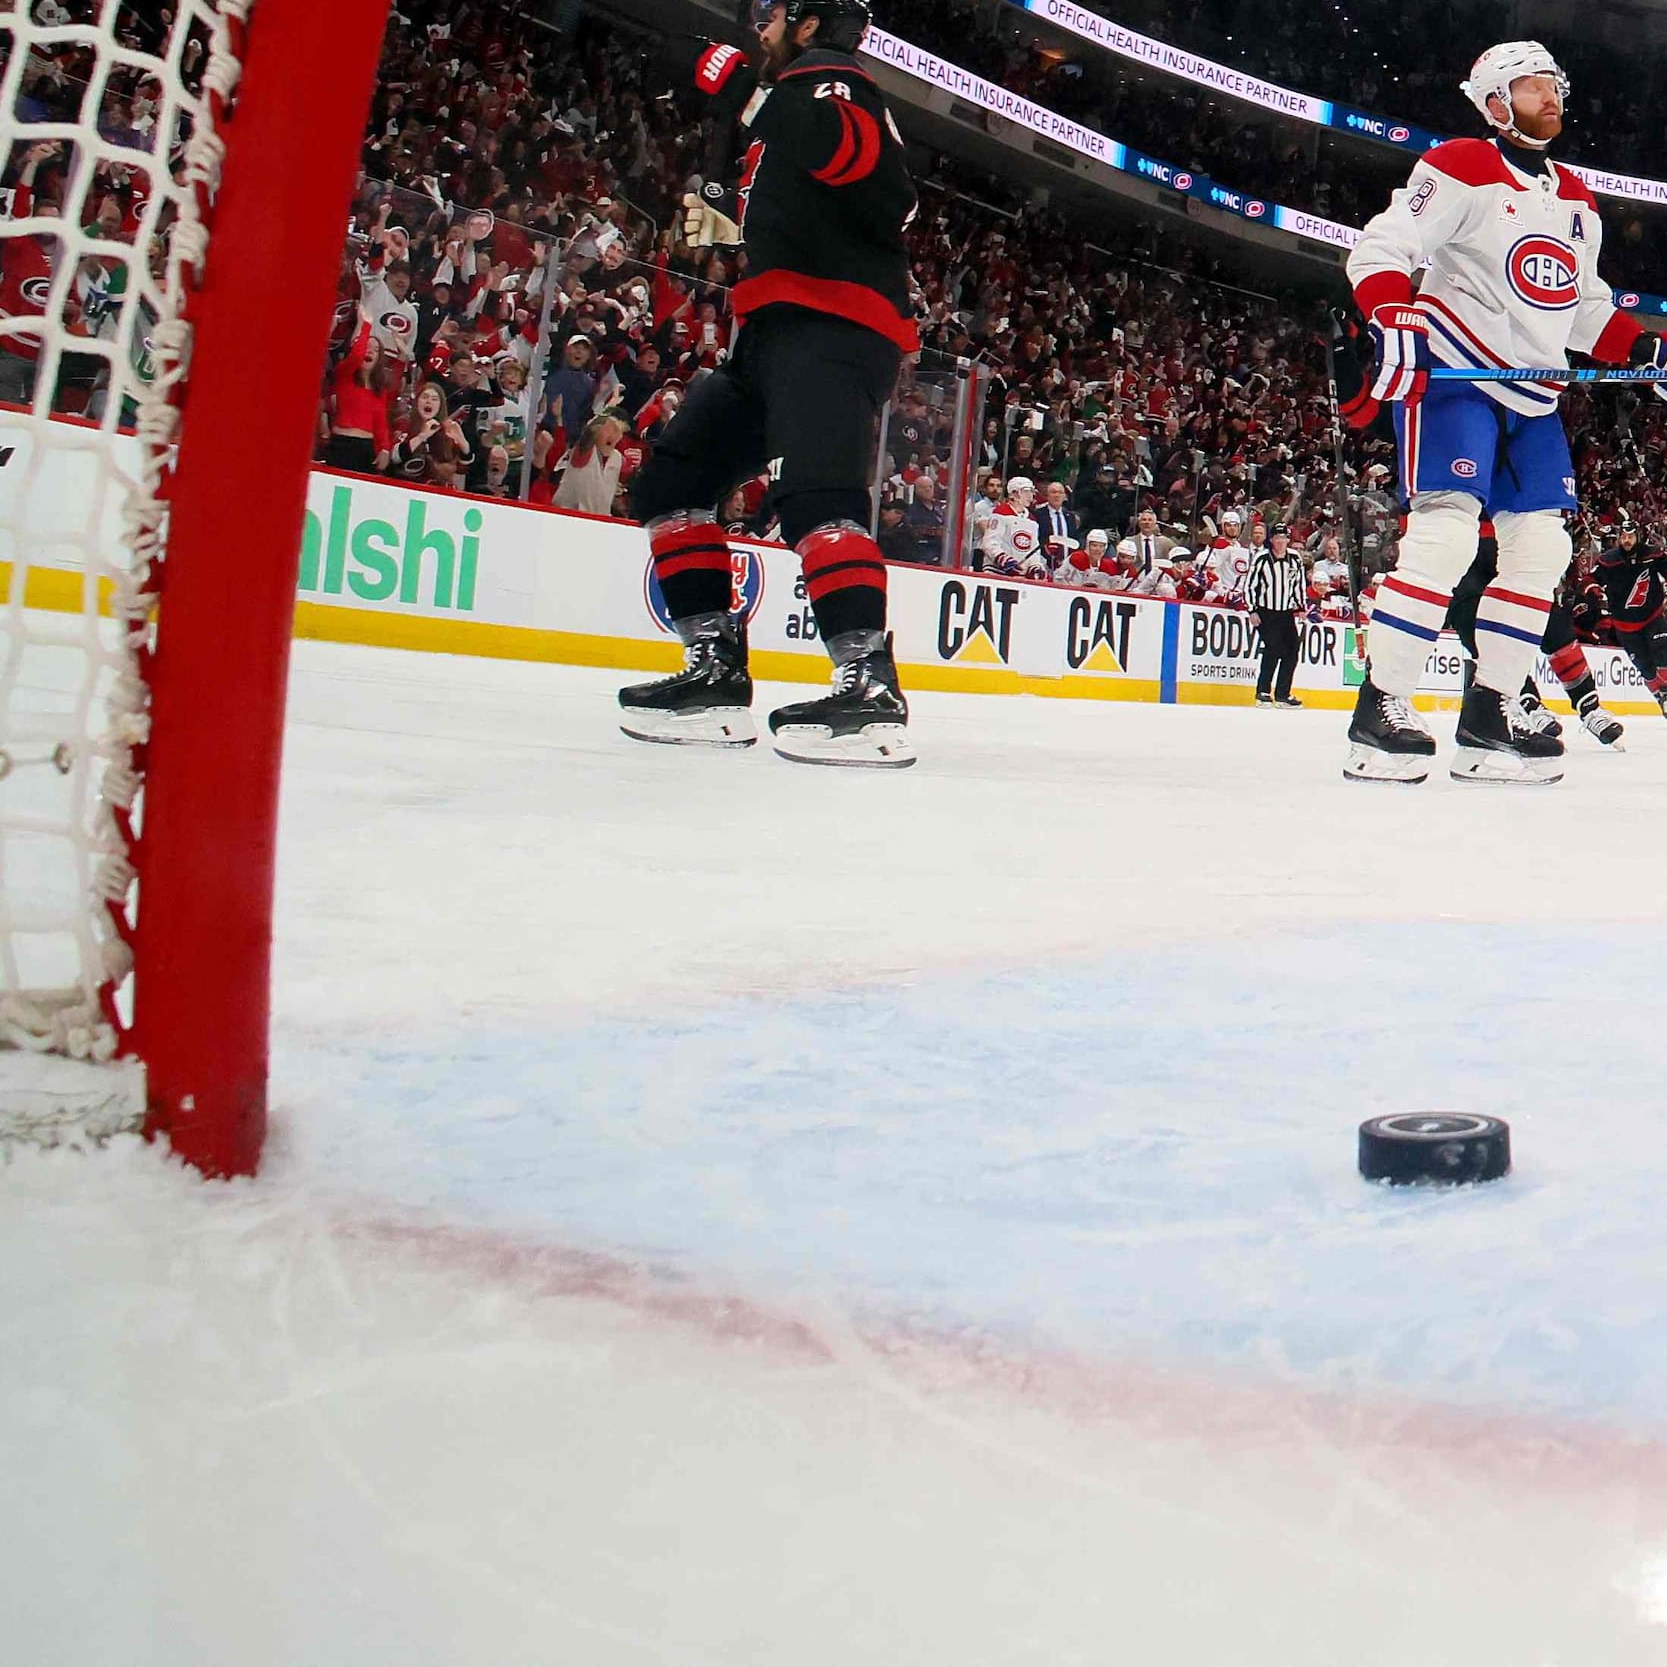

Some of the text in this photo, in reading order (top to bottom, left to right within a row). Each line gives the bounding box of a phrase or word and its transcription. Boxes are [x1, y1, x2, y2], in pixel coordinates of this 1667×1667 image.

[1048, 0, 1307, 114] OFFICIAL HEALTH INSURANCE PARTNER
[917, 54, 1105, 156] HEALTH INSURANCE PARTNER
[1363, 118, 1383, 135] NC
[1152, 164, 1169, 183] NC
[1595, 176, 1651, 198] HEALTH
[1224, 194, 1241, 211] NC
[1409, 178, 1437, 217] 8
[1296, 215, 1352, 244] OFFICIAL
[1569, 210, 1587, 243] A
[938, 580, 1019, 664] CAT
[1067, 596, 1136, 673] CAT
[1191, 663, 1257, 681] SPORTS DRINK
